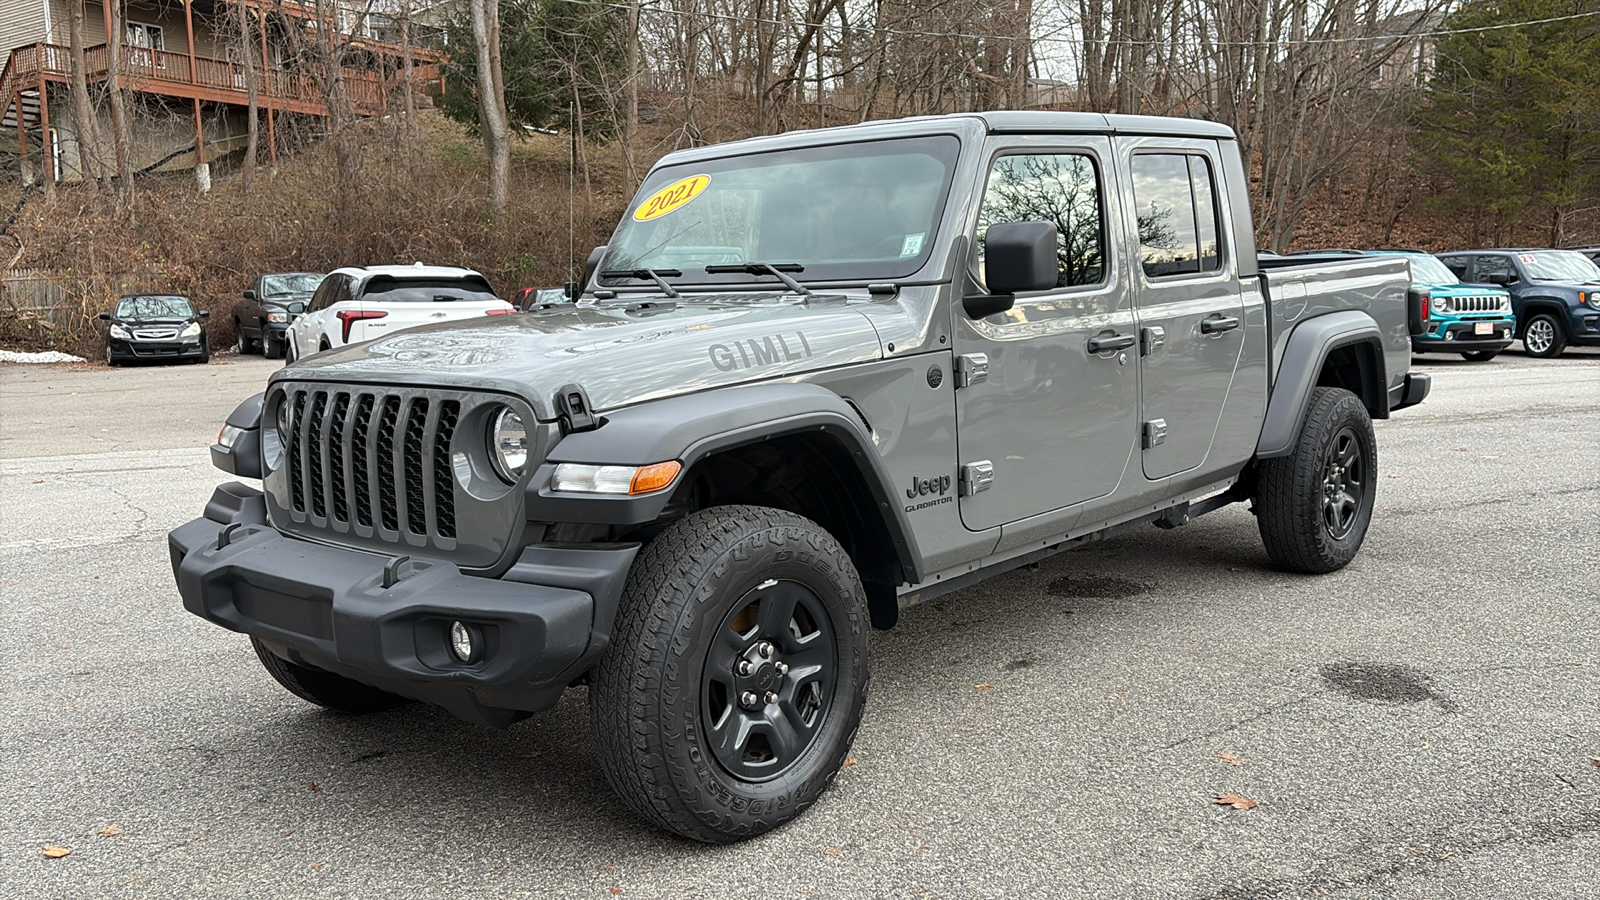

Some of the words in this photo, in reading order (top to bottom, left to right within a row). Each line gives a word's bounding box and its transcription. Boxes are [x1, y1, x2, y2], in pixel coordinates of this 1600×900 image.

[644, 178, 699, 217] 2021
[708, 331, 813, 372] GIMLI
[904, 496, 953, 513] GLADIATOR
[906, 474, 951, 499] Jeep
[769, 548, 862, 637] DUELER
